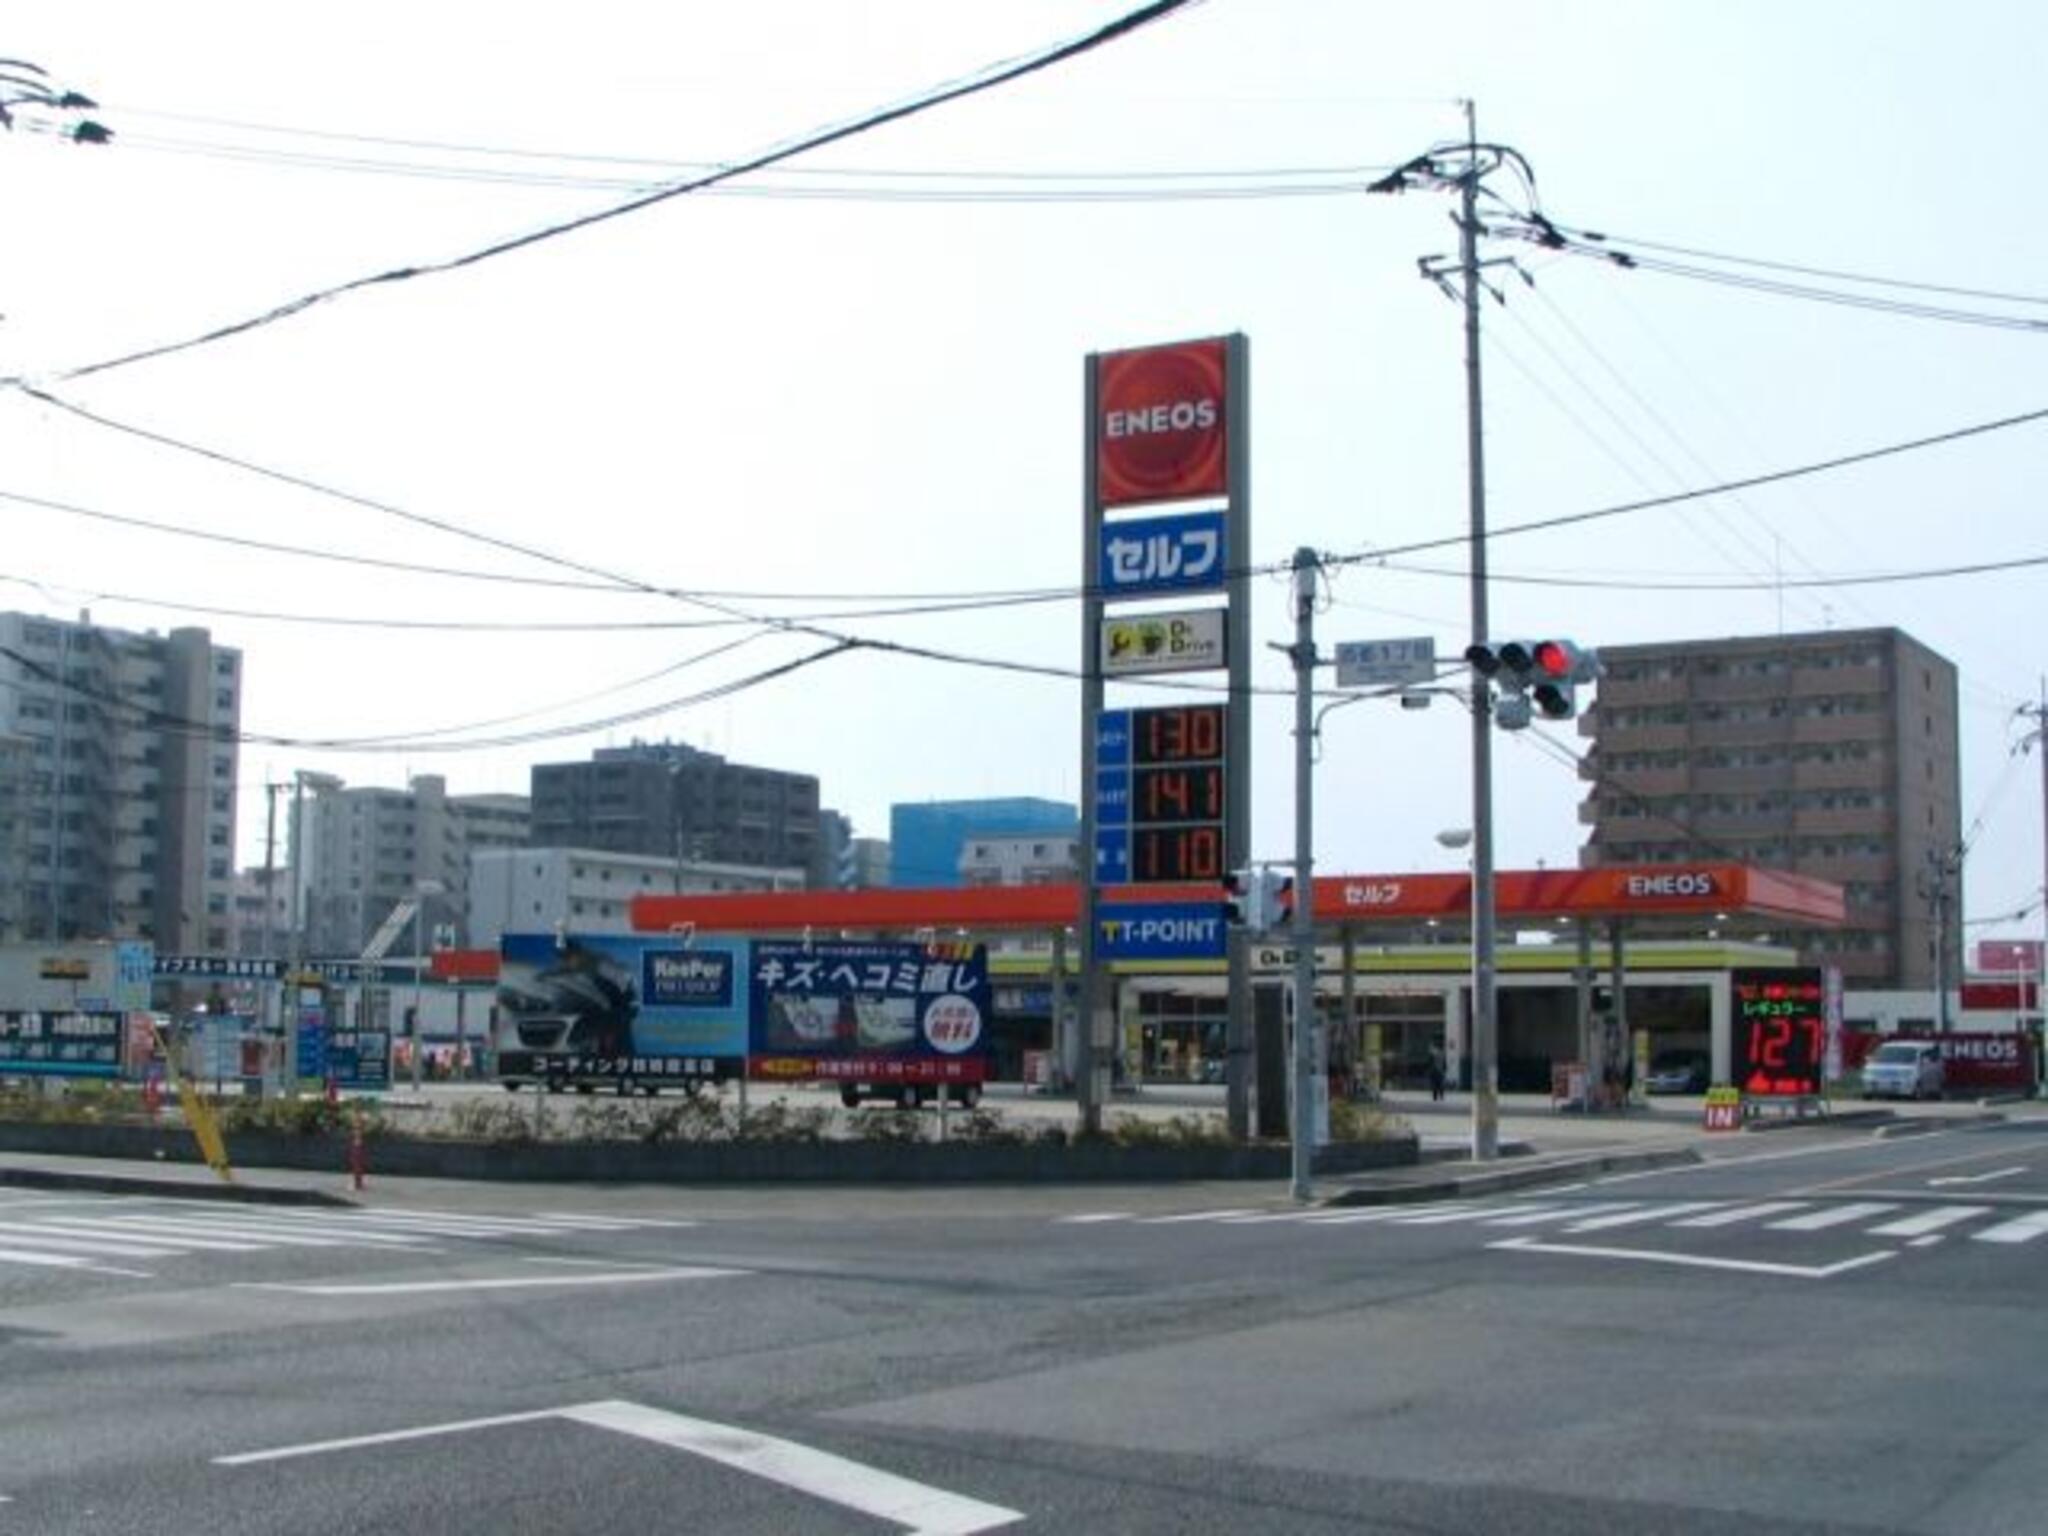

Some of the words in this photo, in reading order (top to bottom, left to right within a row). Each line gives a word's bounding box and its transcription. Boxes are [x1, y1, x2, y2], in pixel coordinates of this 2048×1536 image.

[1106, 399, 1217, 437] ENEOS
[1106, 529, 1218, 584] セルフ
[1150, 709, 1217, 757] 130
[1150, 768, 1219, 817] 141
[1150, 828, 1217, 878] 110
[1345, 882, 1401, 905] セルフ
[1628, 872, 1711, 896] ENEOS
[1121, 917, 1217, 943] T-POINT
[757, 957, 979, 993] キズ・ヘコミ直し
[1743, 1000, 1807, 1016] レギュラー
[1749, 1016, 1821, 1068] 127
[1941, 1040, 2018, 1060] ENEOS
[1706, 1106, 1734, 1128] IN
